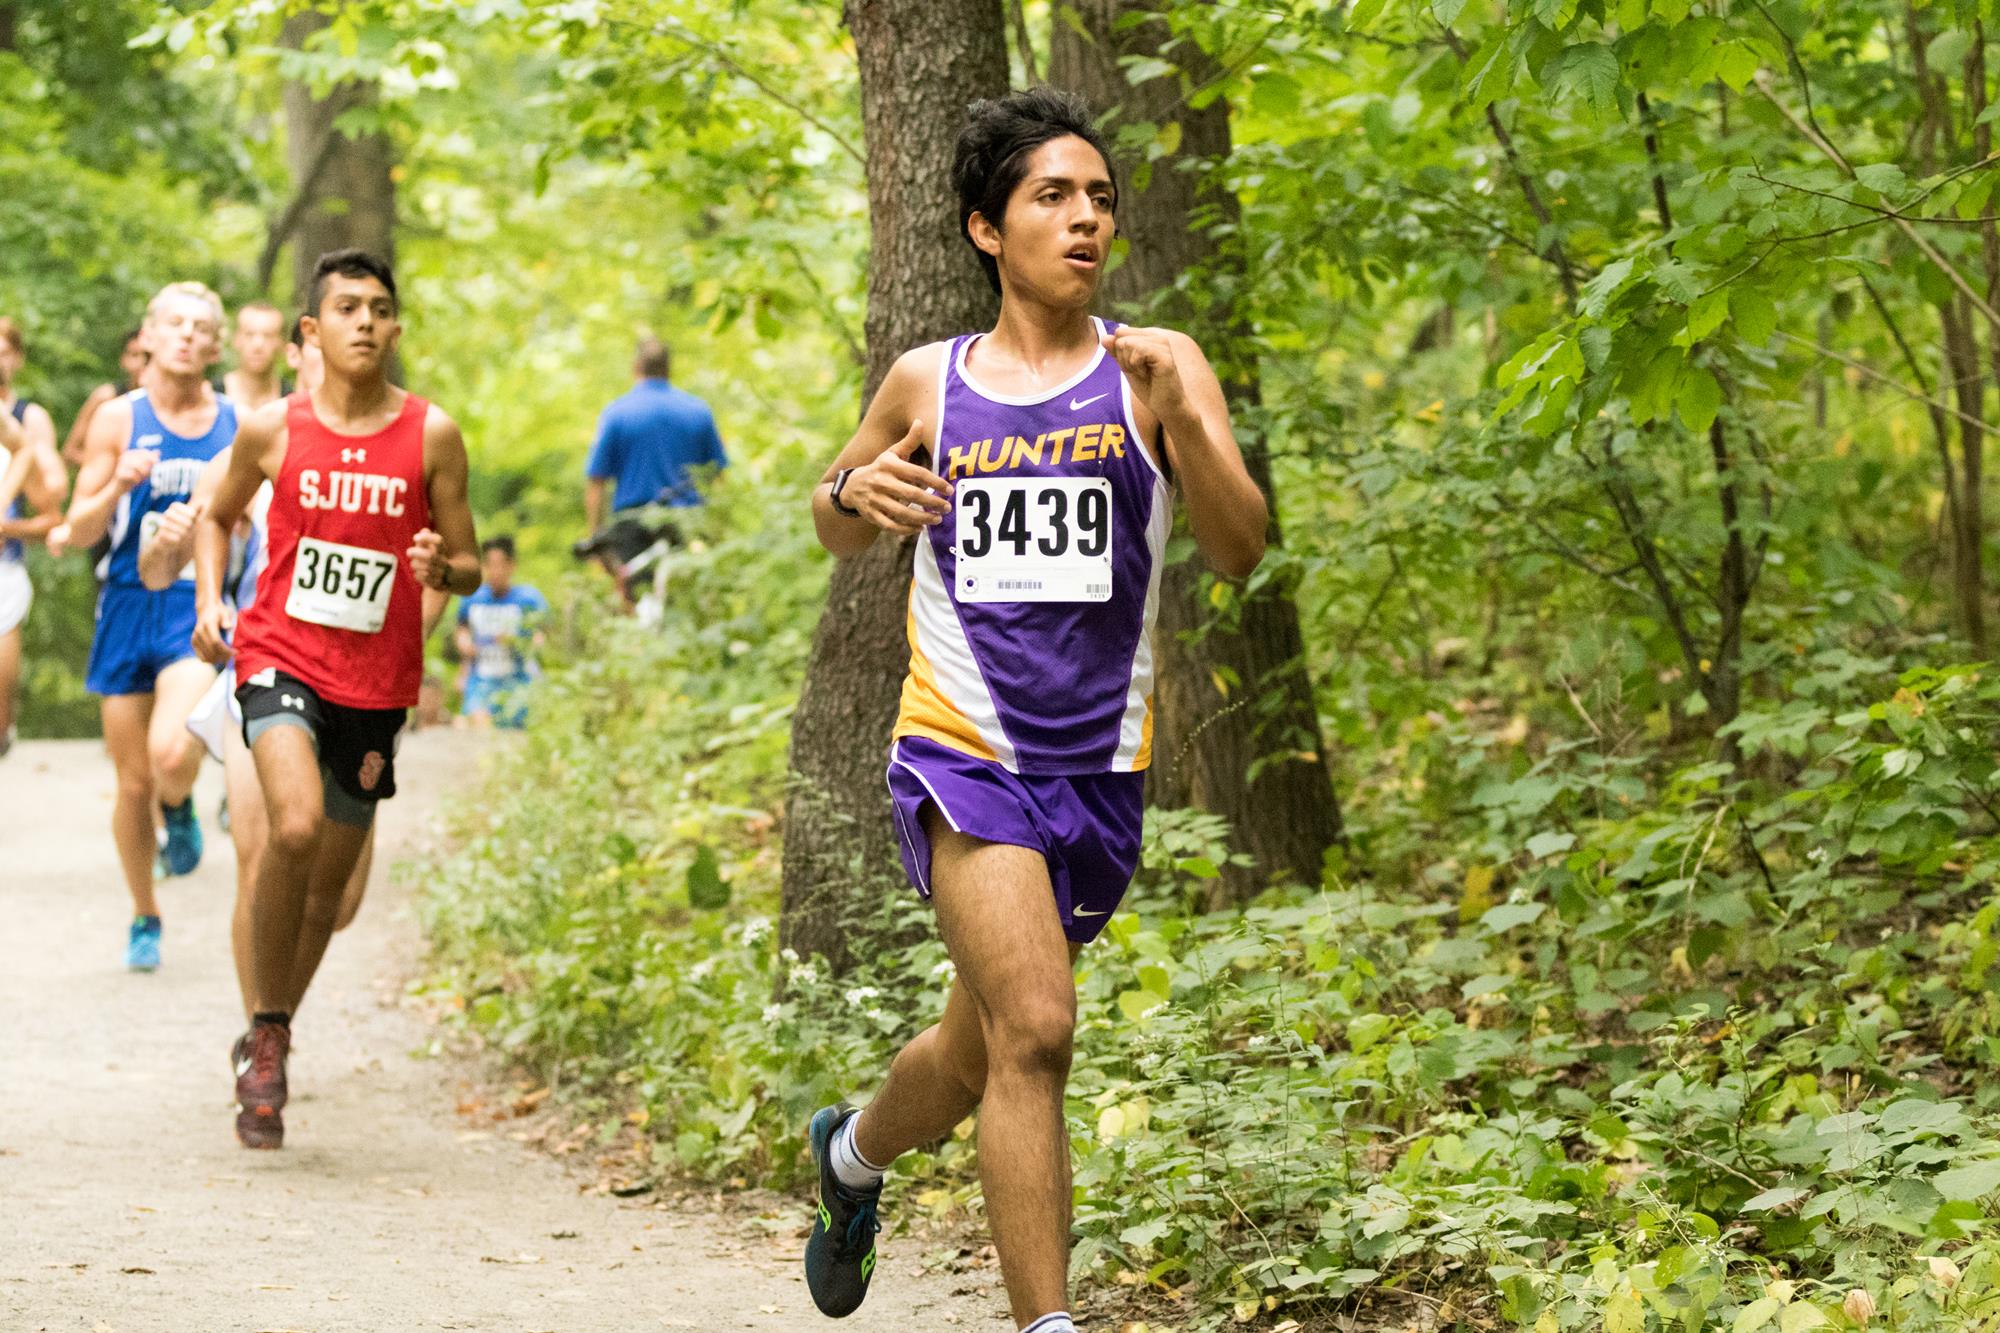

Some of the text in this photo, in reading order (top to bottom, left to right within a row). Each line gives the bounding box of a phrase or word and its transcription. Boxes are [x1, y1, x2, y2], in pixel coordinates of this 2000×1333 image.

[948, 424, 1125, 480] HUNTER
[299, 469, 407, 517] SJUTC
[962, 488, 1108, 557] 3439
[298, 547, 393, 602] 3657
